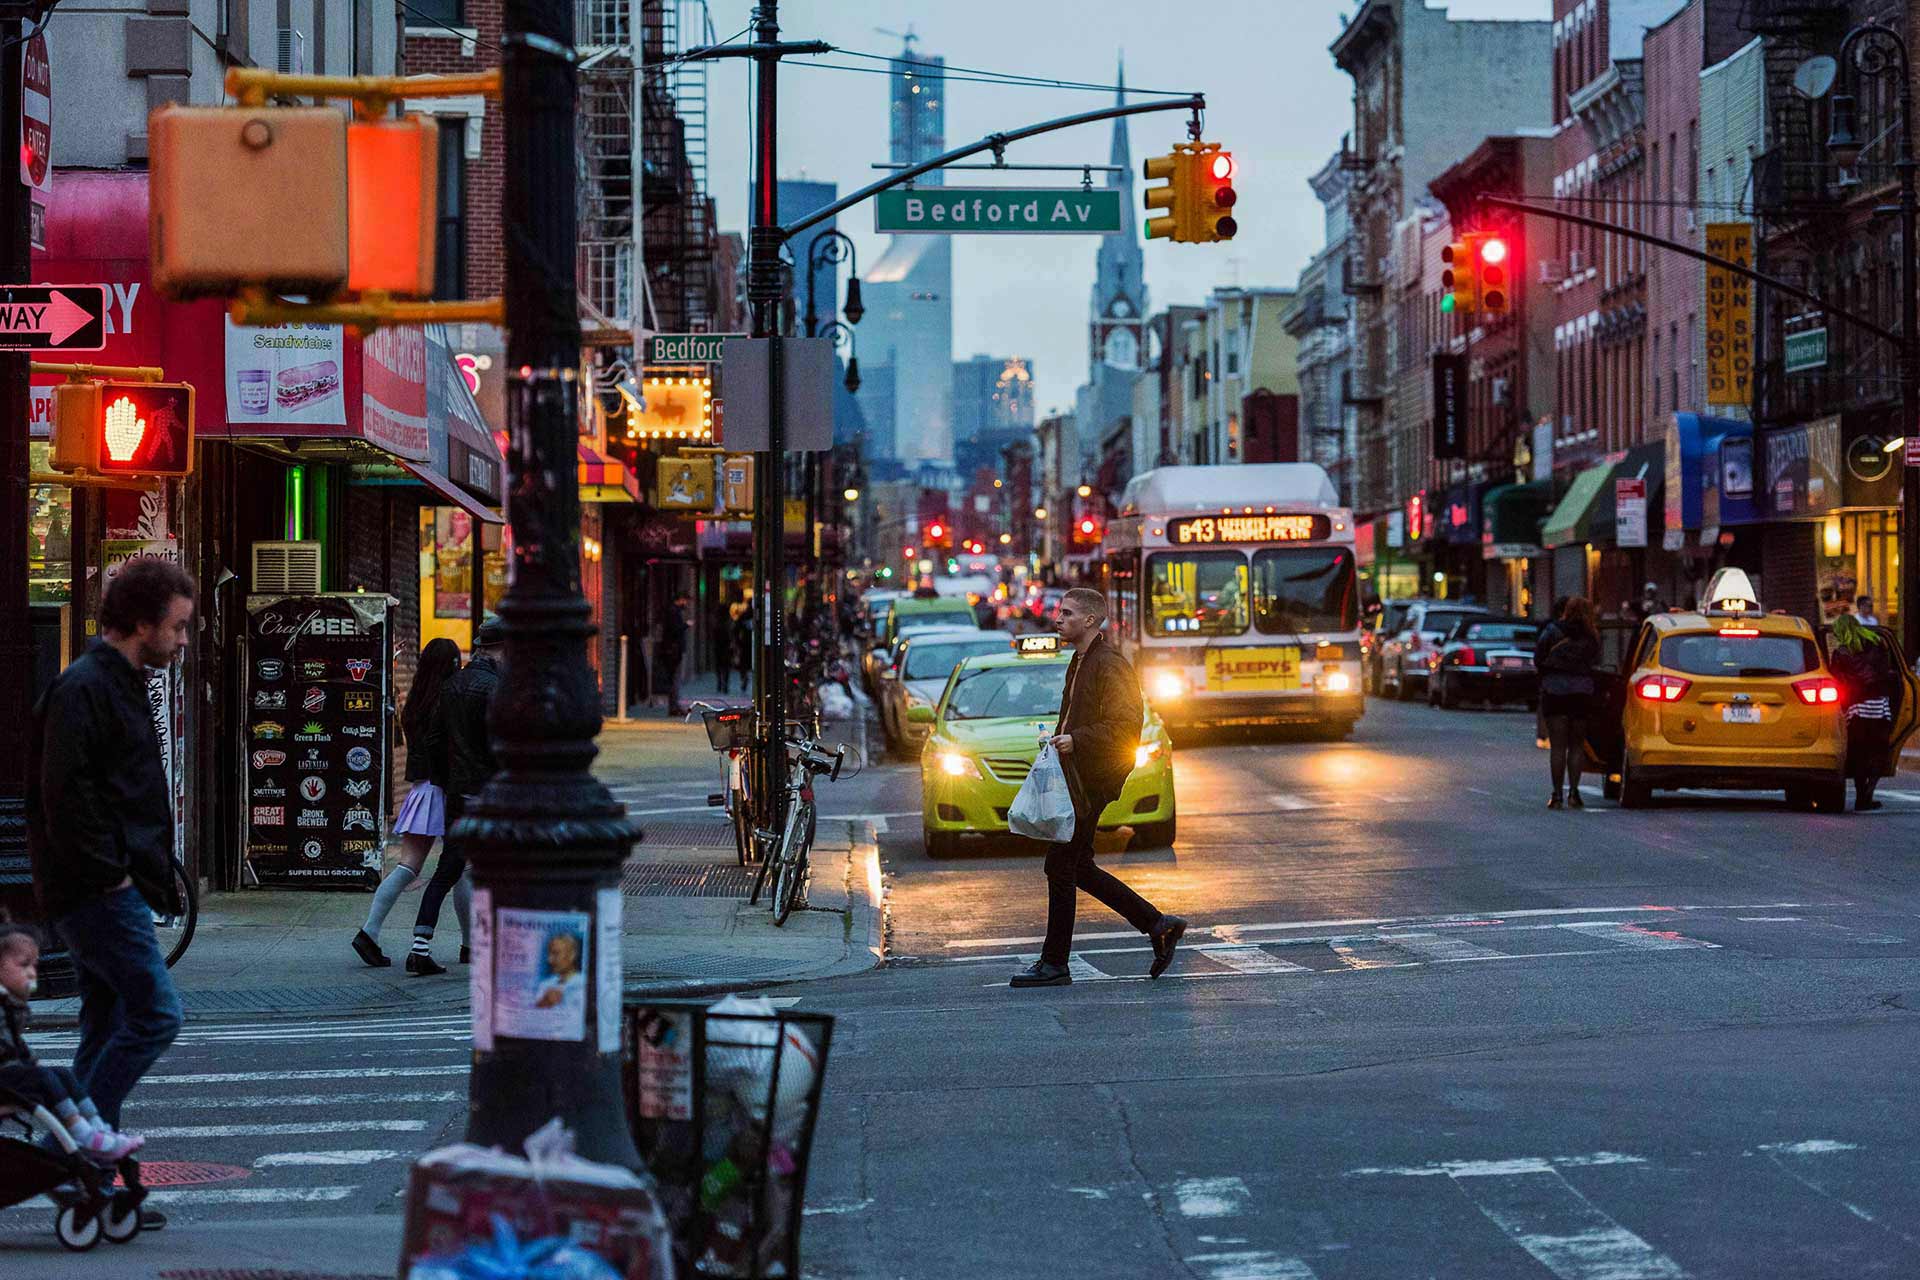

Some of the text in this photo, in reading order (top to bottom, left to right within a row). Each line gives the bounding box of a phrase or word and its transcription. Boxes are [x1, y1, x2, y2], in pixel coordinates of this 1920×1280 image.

[27, 55, 49, 87] DO NOT
[28, 128, 46, 157] ENTER
[906, 198, 1092, 222] Bedford Av
[1711, 277, 1725, 320] BUY
[0, 306, 46, 329] WAY
[1732, 238, 1748, 390] PAWN SHOP
[253, 334, 332, 350] Sandwiches
[1709, 330, 1726, 391] GOLD
[1179, 518, 1215, 543] B43
[260, 609, 320, 650] Craft
[294, 733, 332, 742] Green Flash
[254, 806, 280, 816] GREAT
[254, 816, 281, 825] DIVIDE
[297, 817, 329, 826] BREWERY
[302, 808, 325, 818] BRONX
